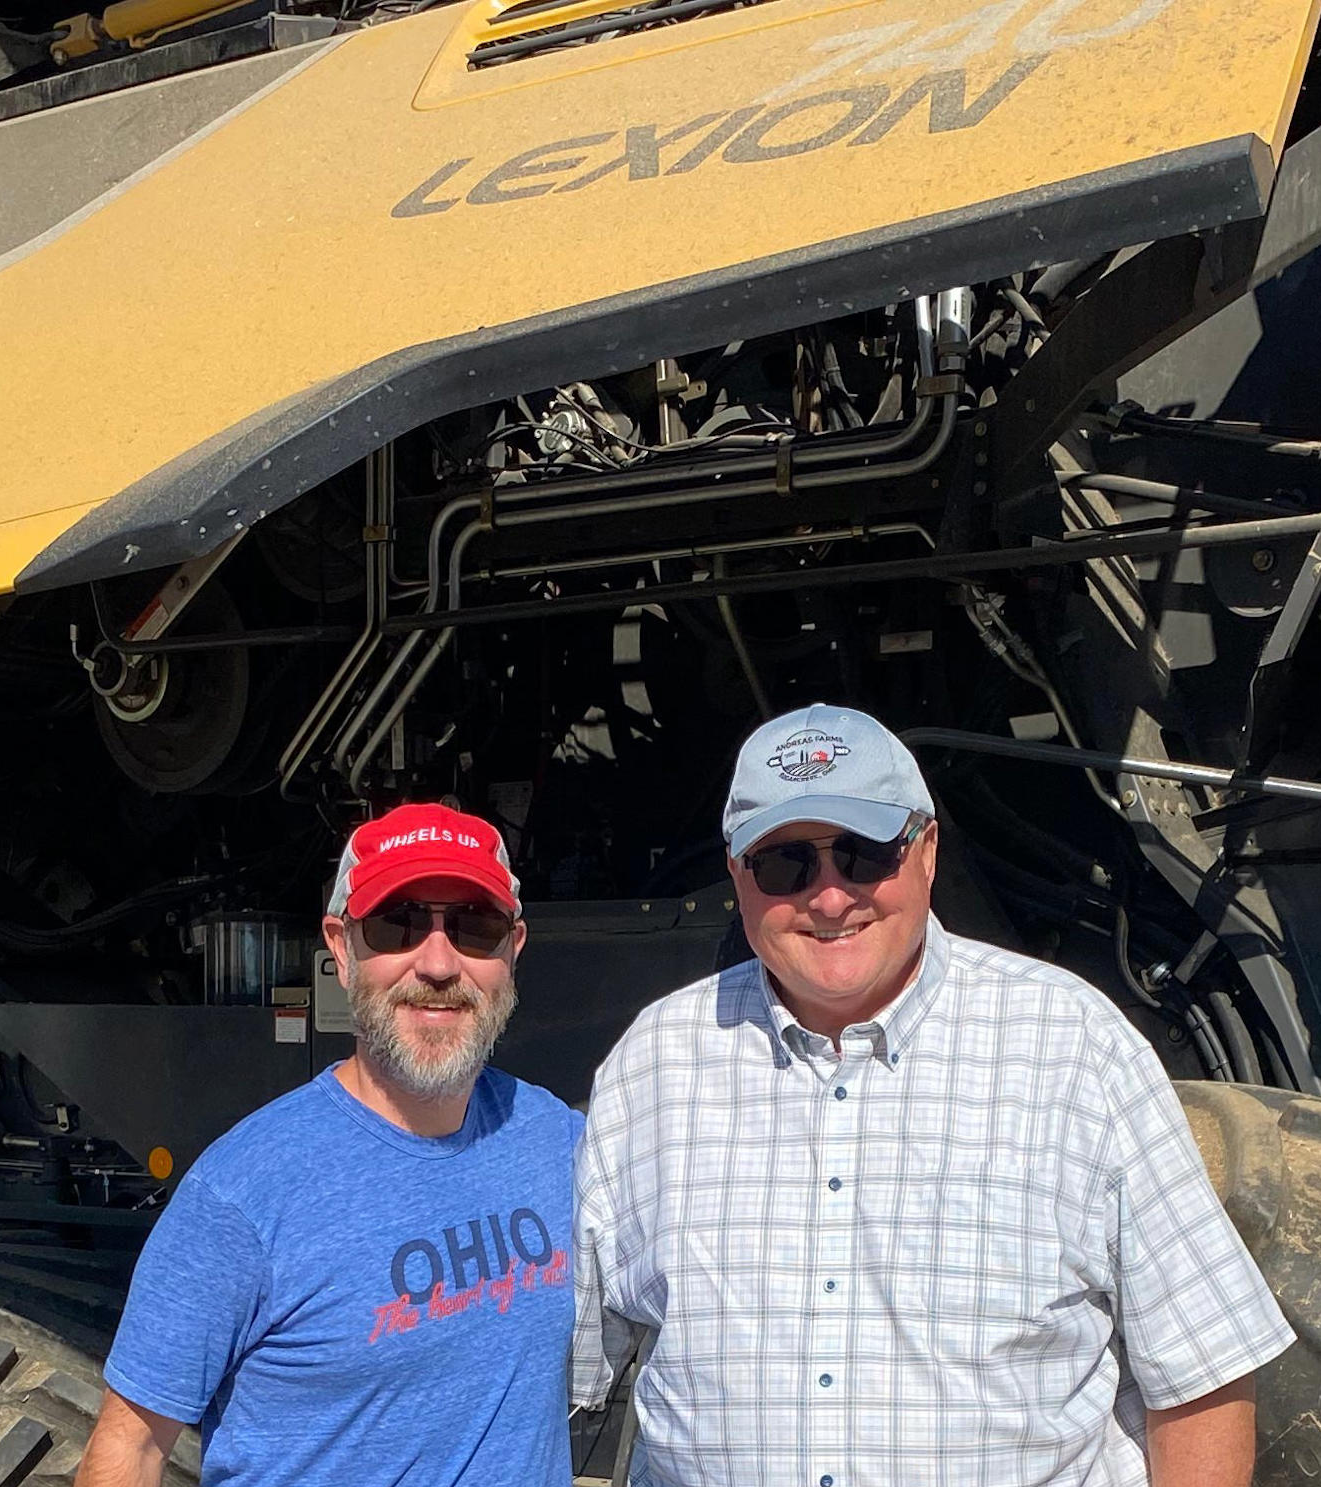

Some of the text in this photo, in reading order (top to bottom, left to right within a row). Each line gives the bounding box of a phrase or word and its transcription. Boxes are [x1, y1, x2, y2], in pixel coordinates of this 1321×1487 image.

[390, 54, 1049, 217] LEXION
[775, 735, 843, 752] ANDREAS FARMS
[380, 827, 480, 853] WHEELS UP
[390, 1208, 553, 1304] OHIO
[368, 1294, 420, 1345] The
[429, 1277, 486, 1320] heart
[488, 1257, 519, 1314] of
[523, 1262, 538, 1291] it
